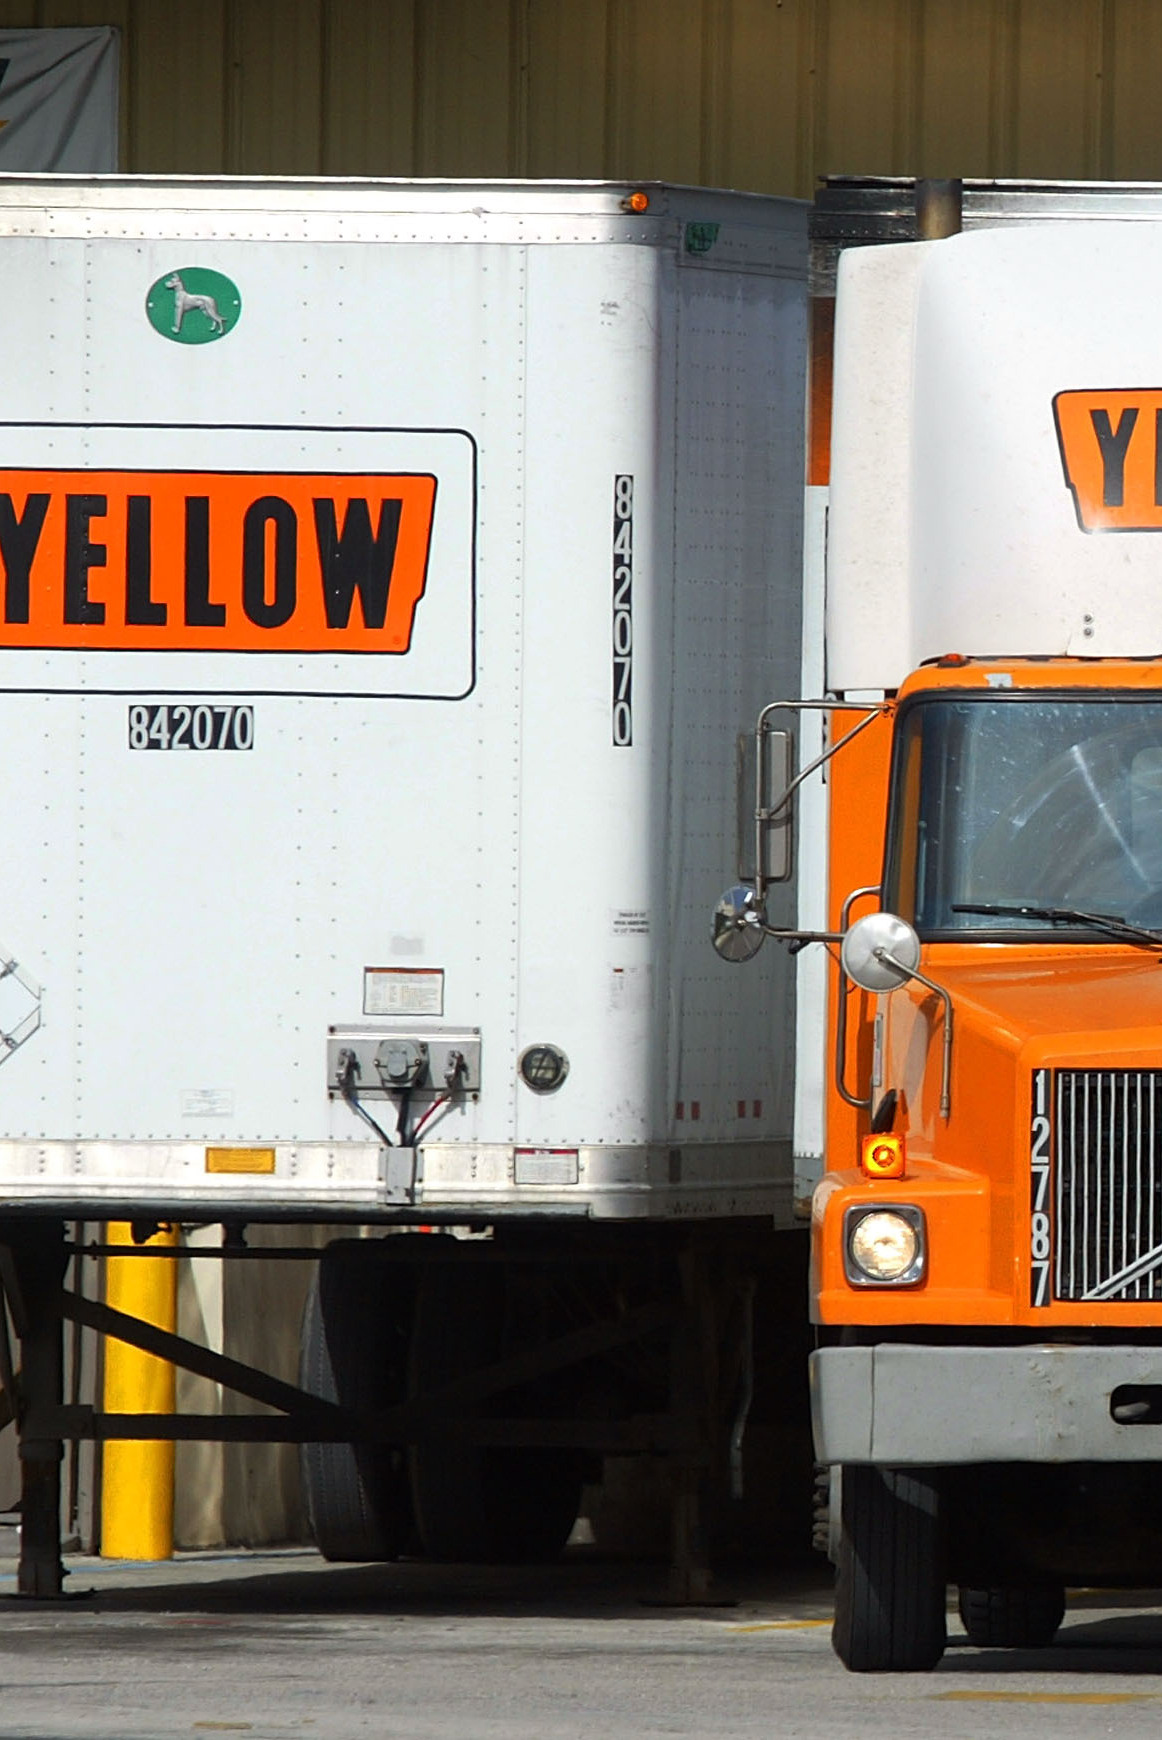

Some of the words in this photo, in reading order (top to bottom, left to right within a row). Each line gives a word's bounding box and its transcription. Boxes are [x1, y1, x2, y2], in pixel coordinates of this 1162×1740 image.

[0, 493, 403, 629] YELLOW
[613, 475, 633, 746] 842070
[129, 704, 253, 749] 842070
[1031, 1069, 1050, 1307] 12787
